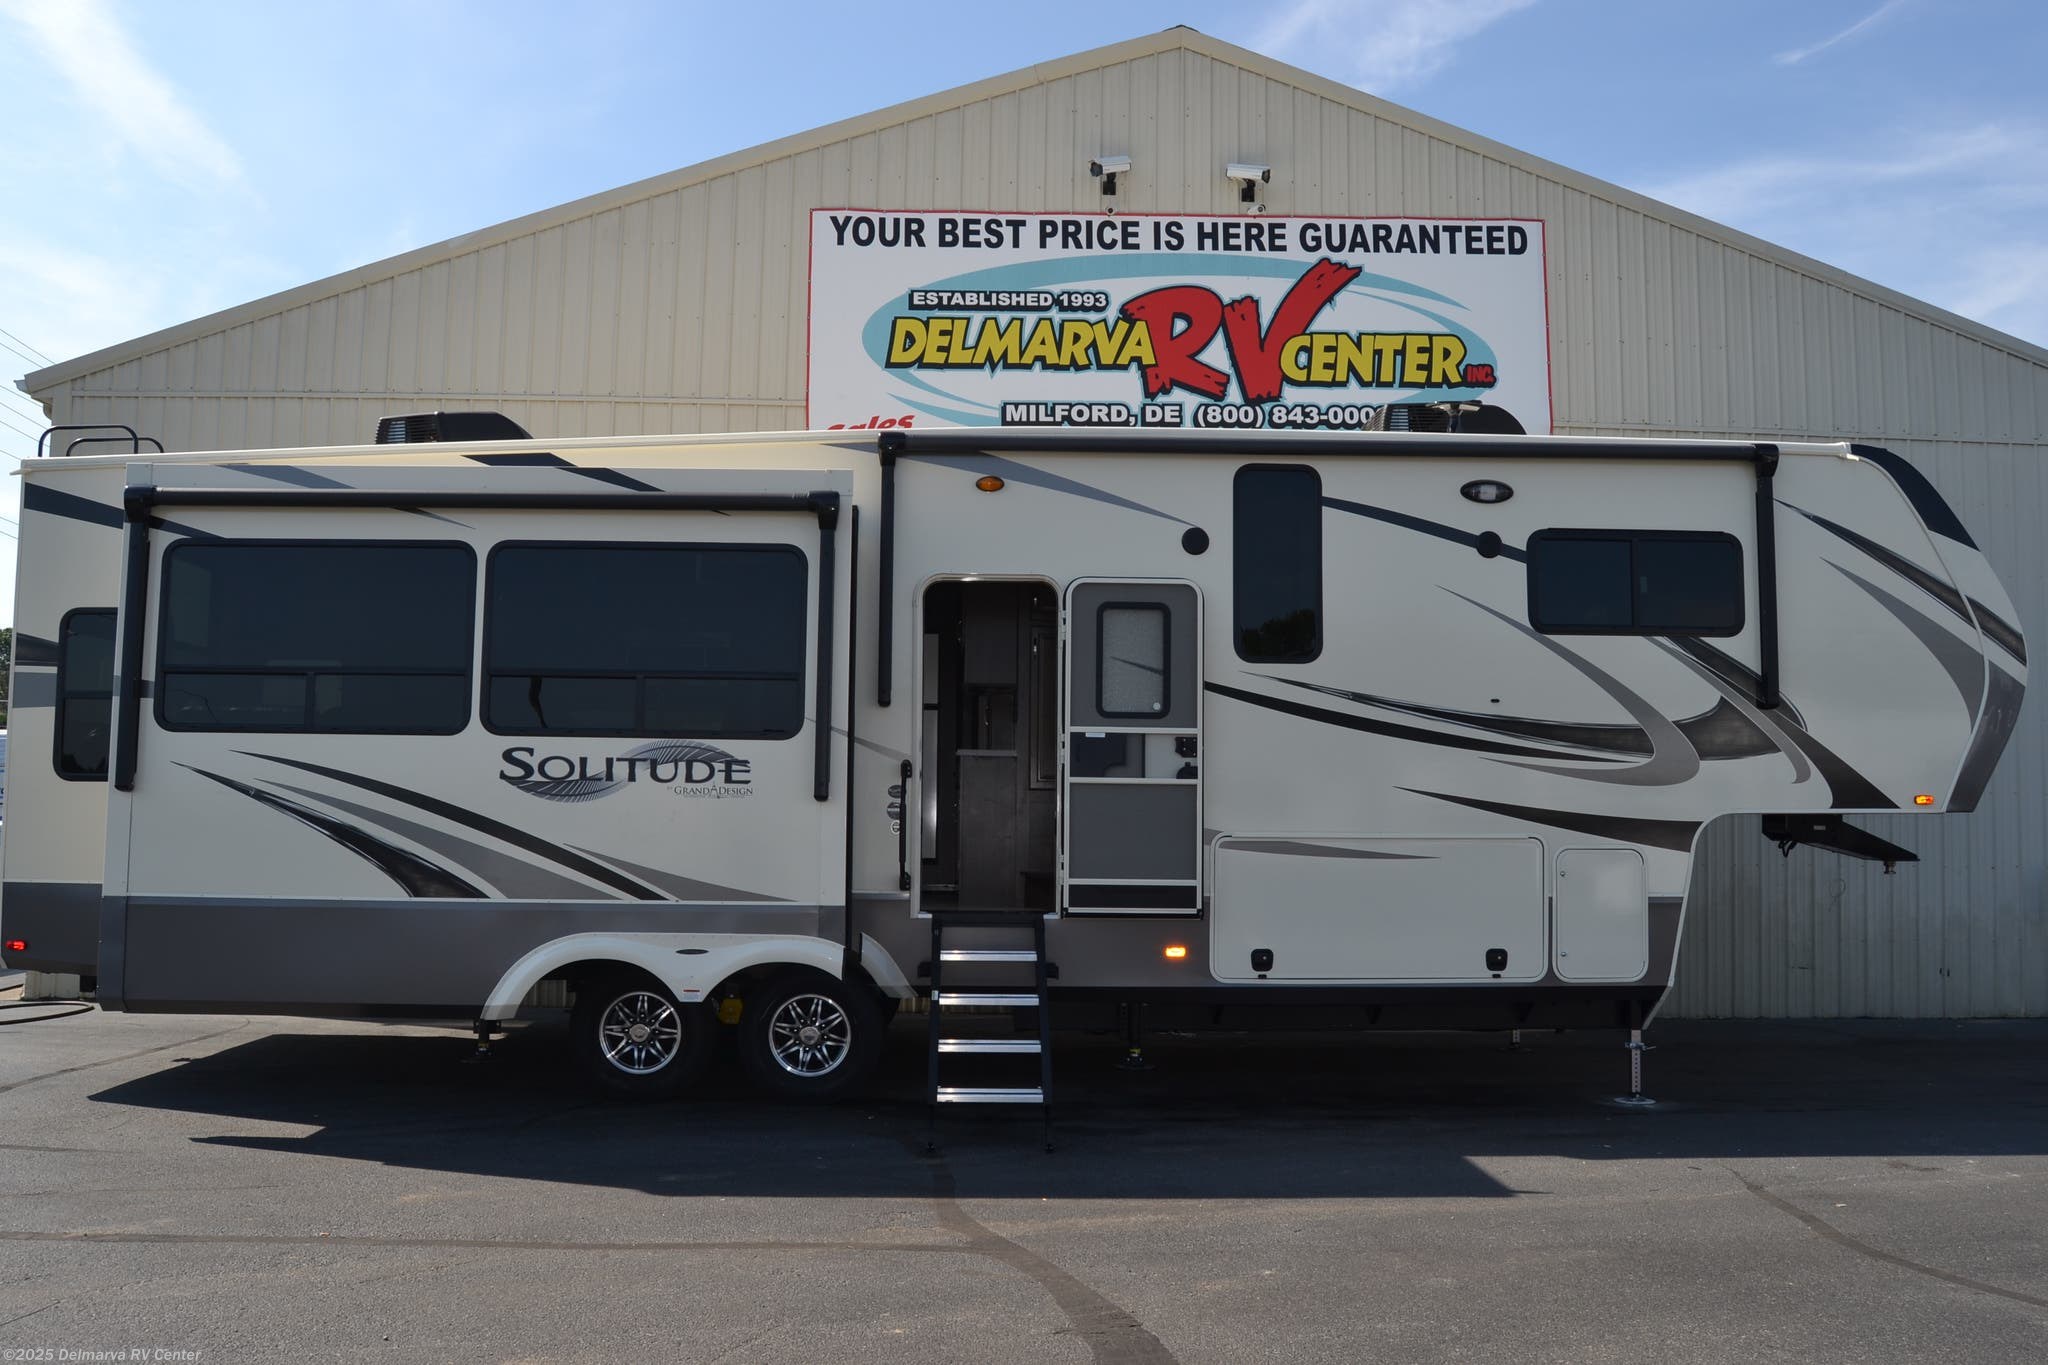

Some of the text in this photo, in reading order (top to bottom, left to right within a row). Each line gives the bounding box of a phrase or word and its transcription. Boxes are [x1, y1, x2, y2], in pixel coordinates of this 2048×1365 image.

[830, 216, 1528, 255] YOUR BEST PRICE IS HERE GUARANTEED
[912, 291, 1107, 307] ESTABLISHED 1993
[887, 257, 1495, 405] DELMARVA RV CENTER INC.
[1005, 404, 1384, 426] MILFORD, DE (800) 843-000
[499, 747, 752, 784] SOLITUDE
